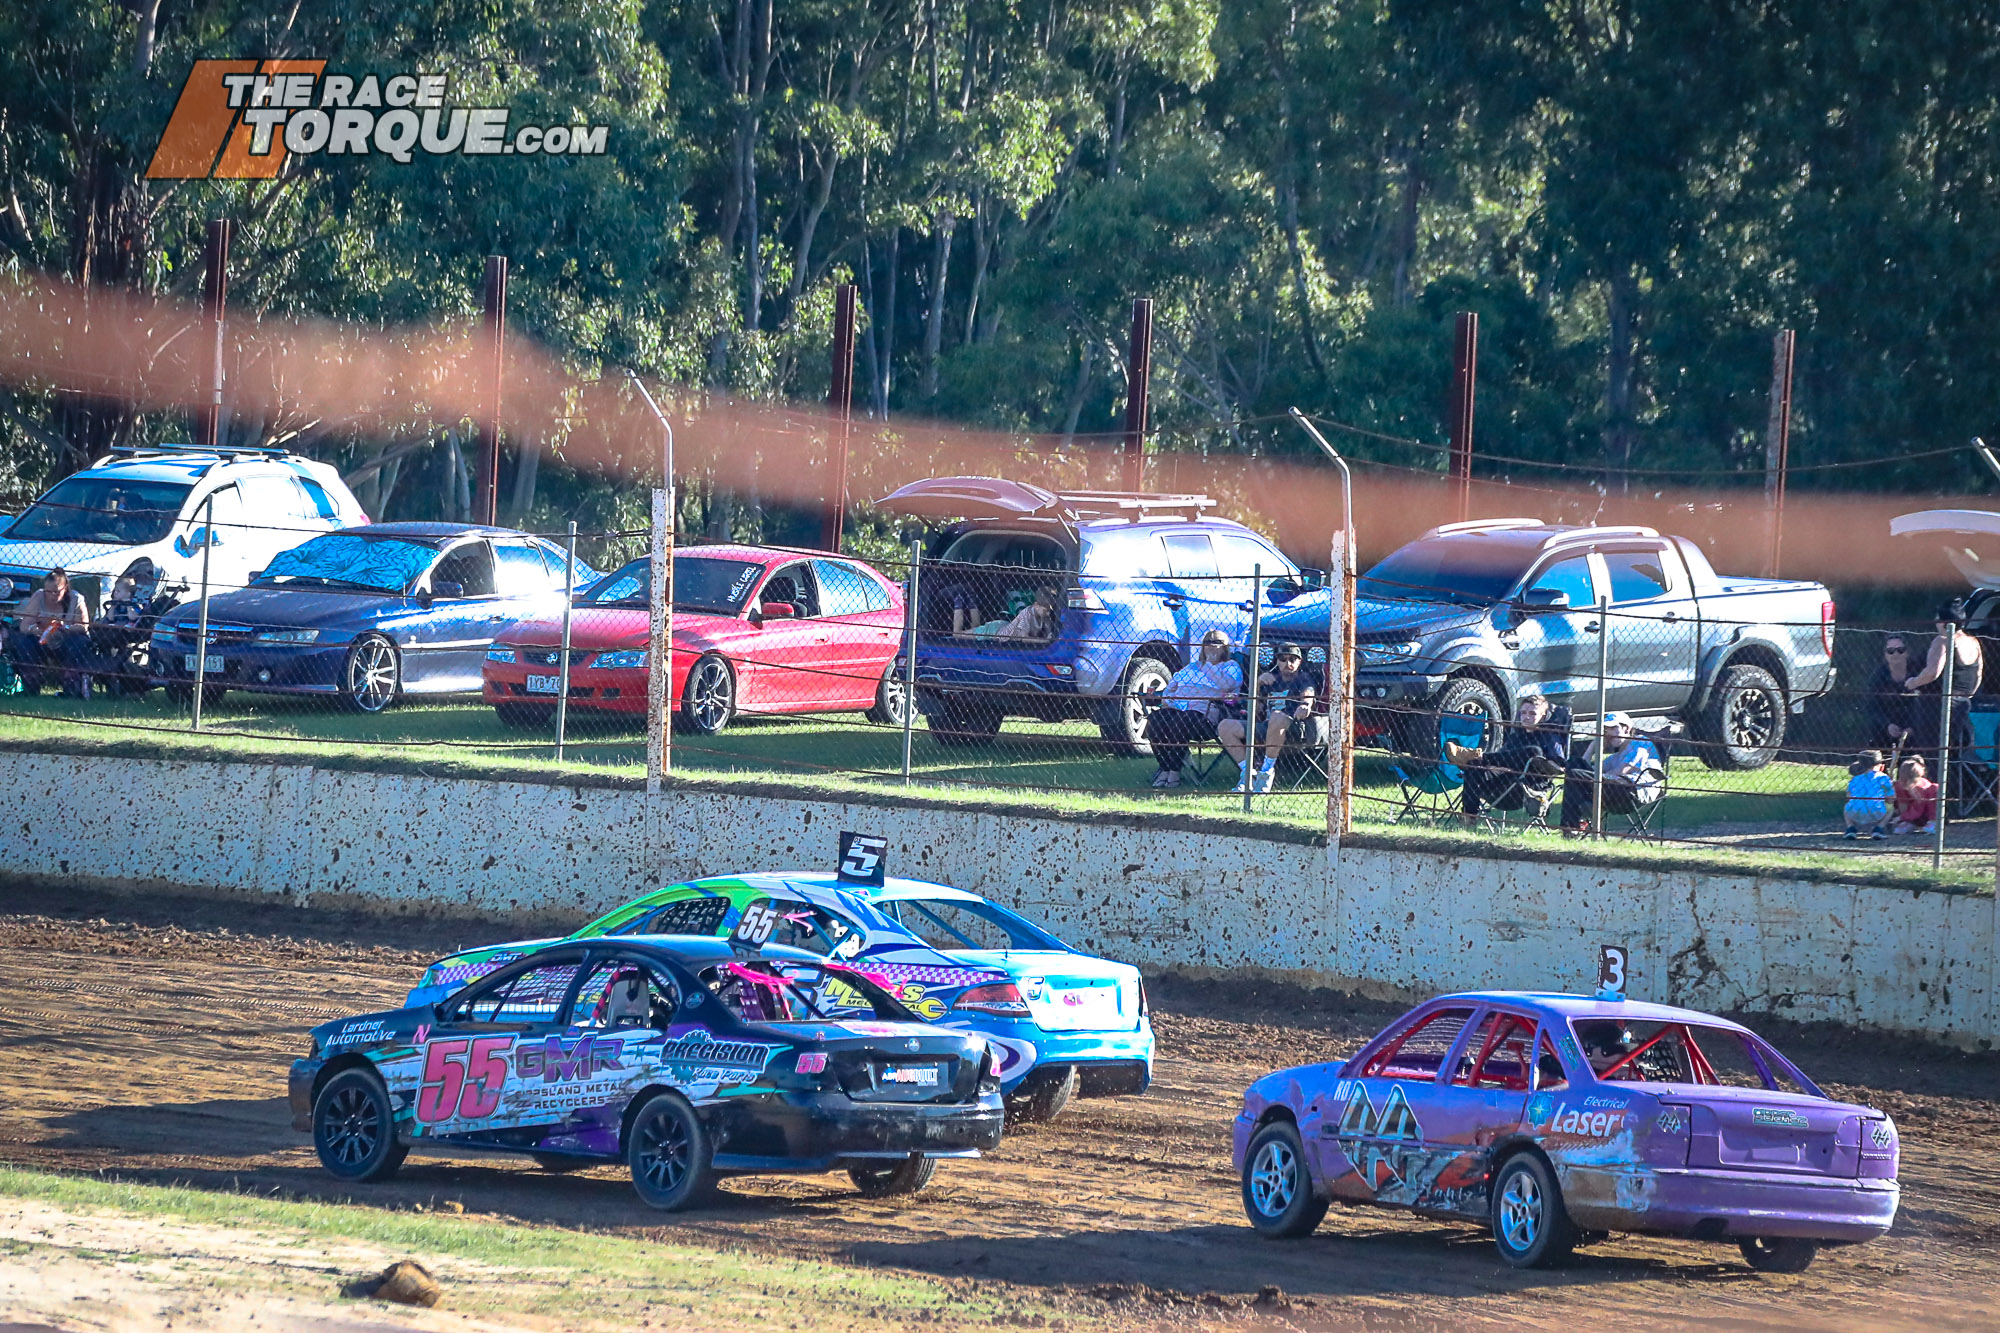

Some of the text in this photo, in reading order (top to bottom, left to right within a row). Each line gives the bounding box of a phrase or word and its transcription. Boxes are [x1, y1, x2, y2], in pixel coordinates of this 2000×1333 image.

[841, 836, 887, 877] 5
[738, 905, 778, 944] 55
[1602, 949, 1625, 992] 3
[326, 1030, 397, 1047] Automotive
[342, 1020, 384, 1034] Lardner
[412, 1024, 432, 1044] N
[515, 1034, 626, 1083] GMR
[661, 1041, 768, 1065] PRECISION
[795, 1053, 828, 1074] 55
[416, 1036, 516, 1124] 55
[1584, 1096, 1630, 1109] Electrical
[1551, 1102, 1620, 1137] Laser
